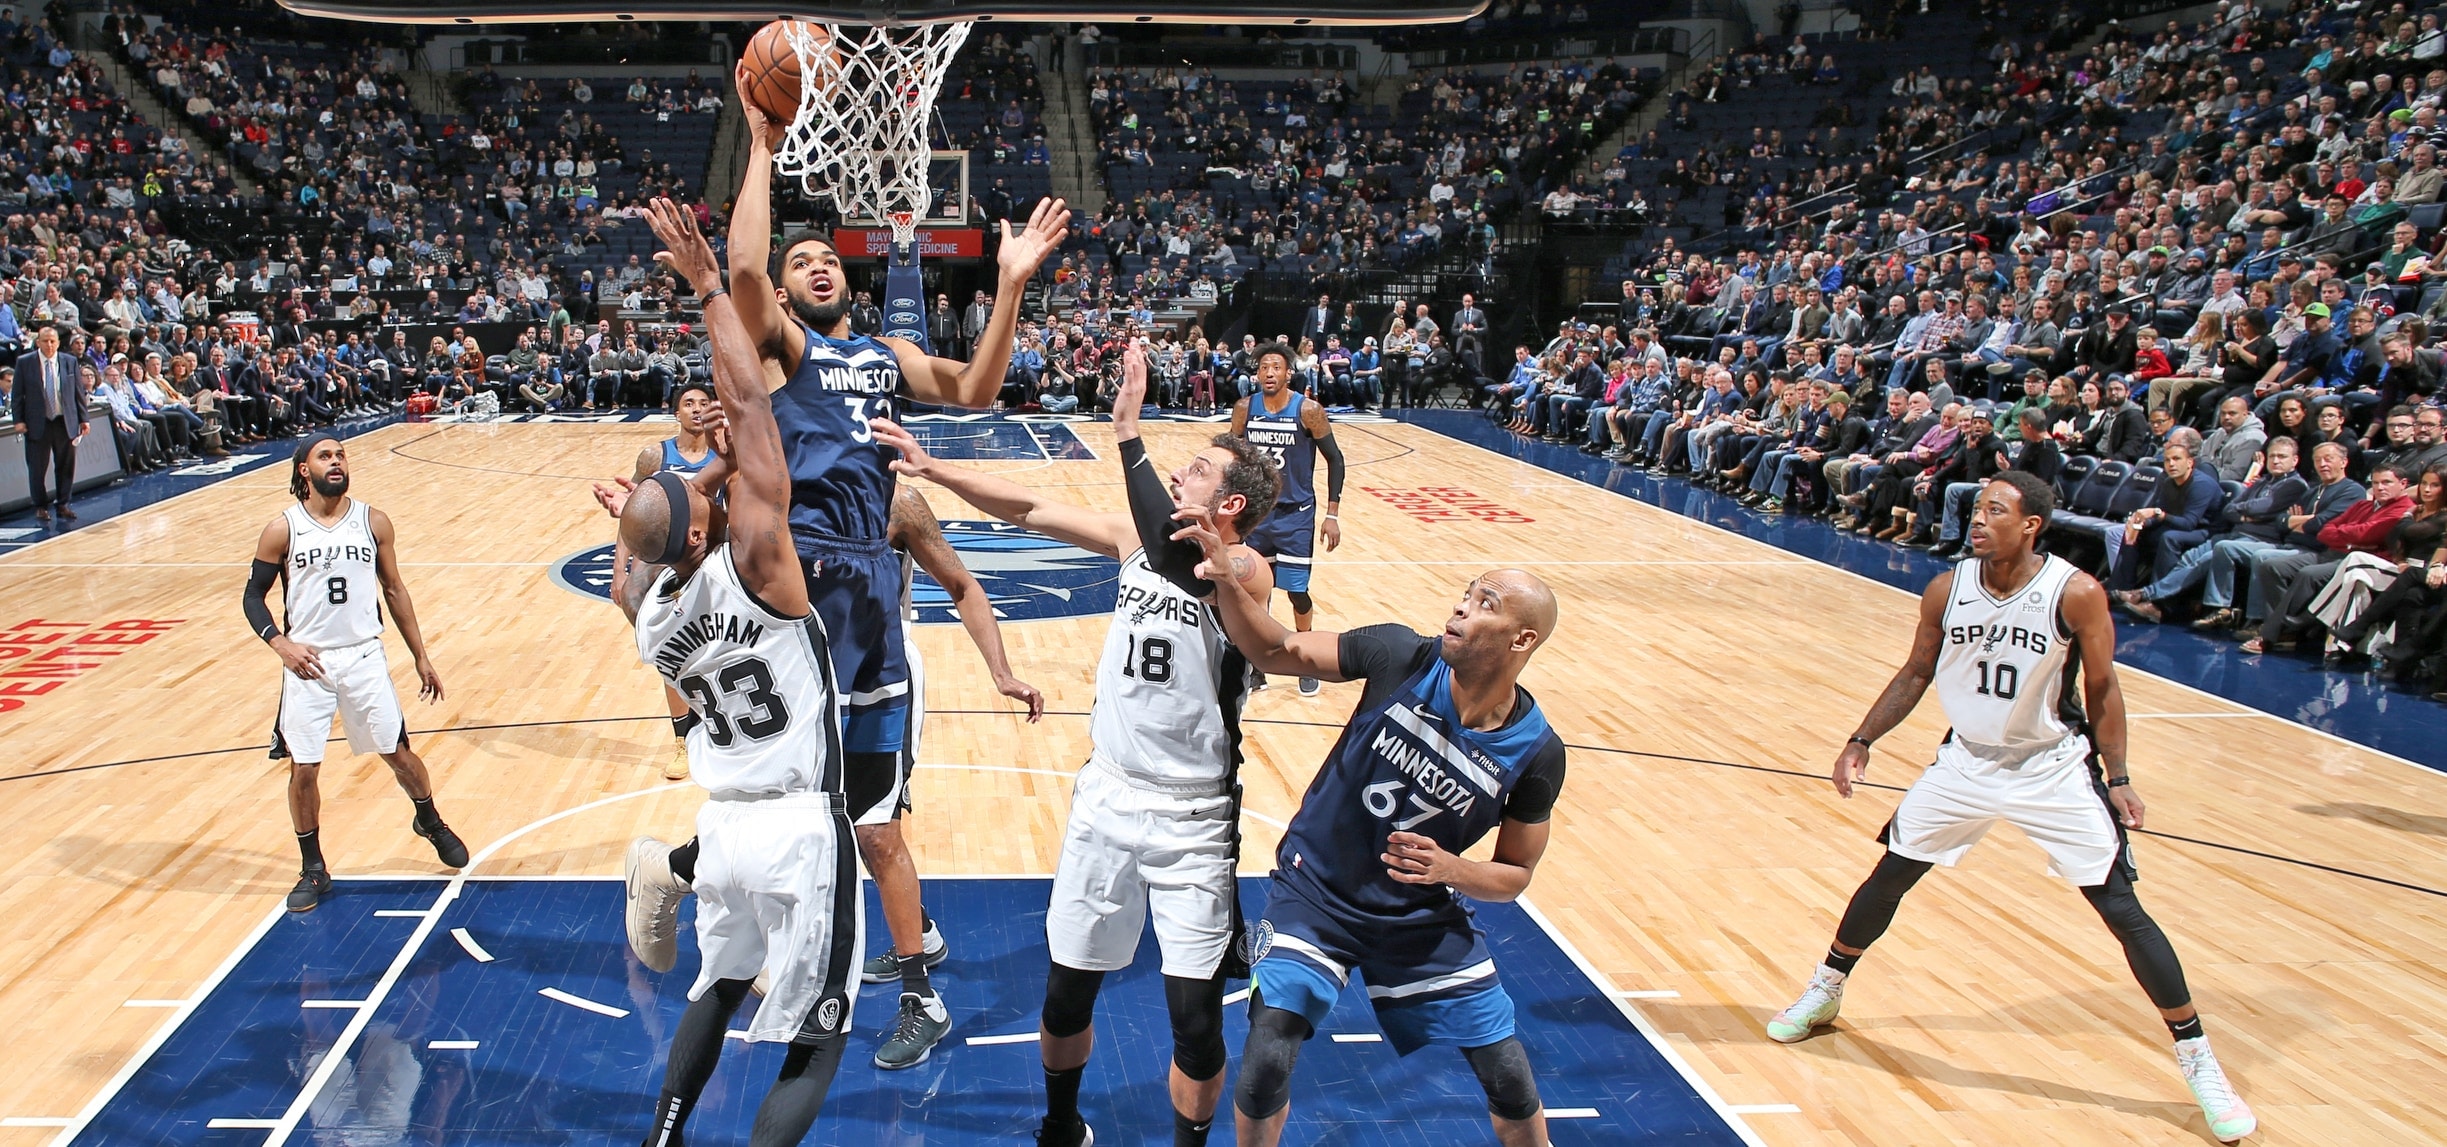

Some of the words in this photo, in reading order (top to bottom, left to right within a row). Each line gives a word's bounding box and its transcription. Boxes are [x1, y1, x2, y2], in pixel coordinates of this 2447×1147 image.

[919, 243, 958, 254] EDICINE
[818, 367, 899, 393] MINNESOT
[1247, 430, 1296, 446] MINNESOTA
[1359, 486, 1471, 523] TARGET
[1417, 486, 1536, 524] CENTER
[295, 545, 372, 570] SPURS
[327, 577, 348, 605] 8
[1118, 584, 1199, 628] SPURS
[2022, 602, 2045, 613] Frost
[656, 612, 764, 682] CUNNINGHAM
[1951, 624, 2047, 655] SPURS
[1122, 632, 1174, 685] 18
[1976, 660, 2018, 700] 10
[680, 656, 790, 747] 33
[1371, 726, 1476, 818] MINNESOTA
[1478, 754, 1501, 776] fitbit
[1361, 779, 1444, 831] 67
